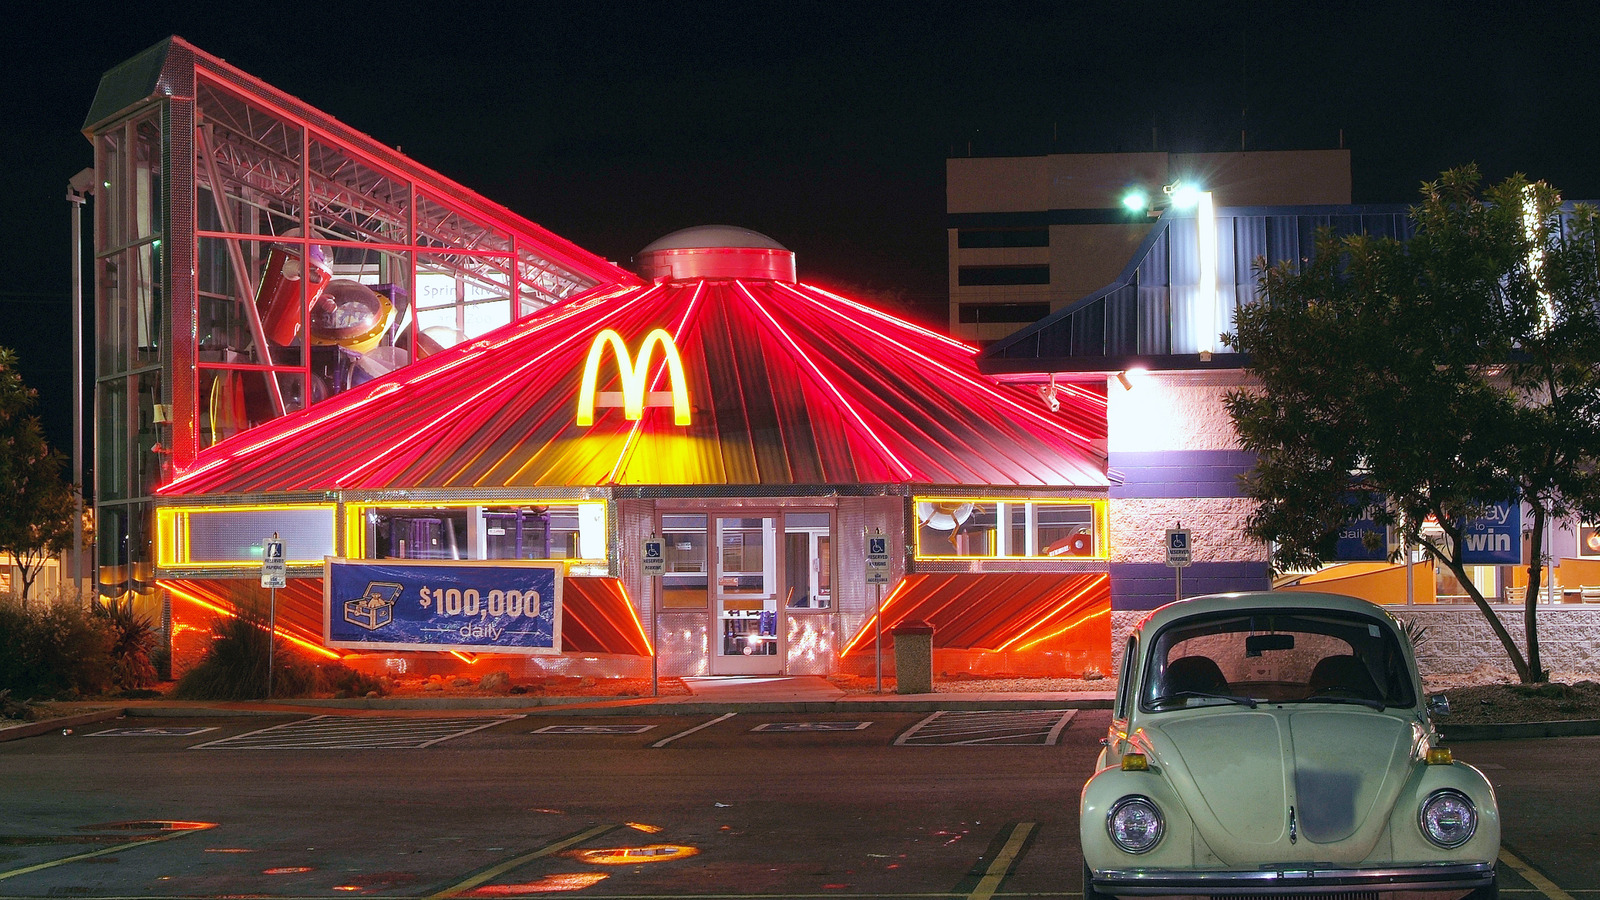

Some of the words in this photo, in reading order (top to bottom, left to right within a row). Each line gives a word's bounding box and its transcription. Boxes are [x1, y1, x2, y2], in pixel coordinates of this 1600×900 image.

[423, 284, 457, 298] Sprin
[1475, 522, 1485, 531] to
[1466, 528, 1511, 551] win
[419, 586, 540, 620] $100,000
[459, 622, 502, 641] daily
